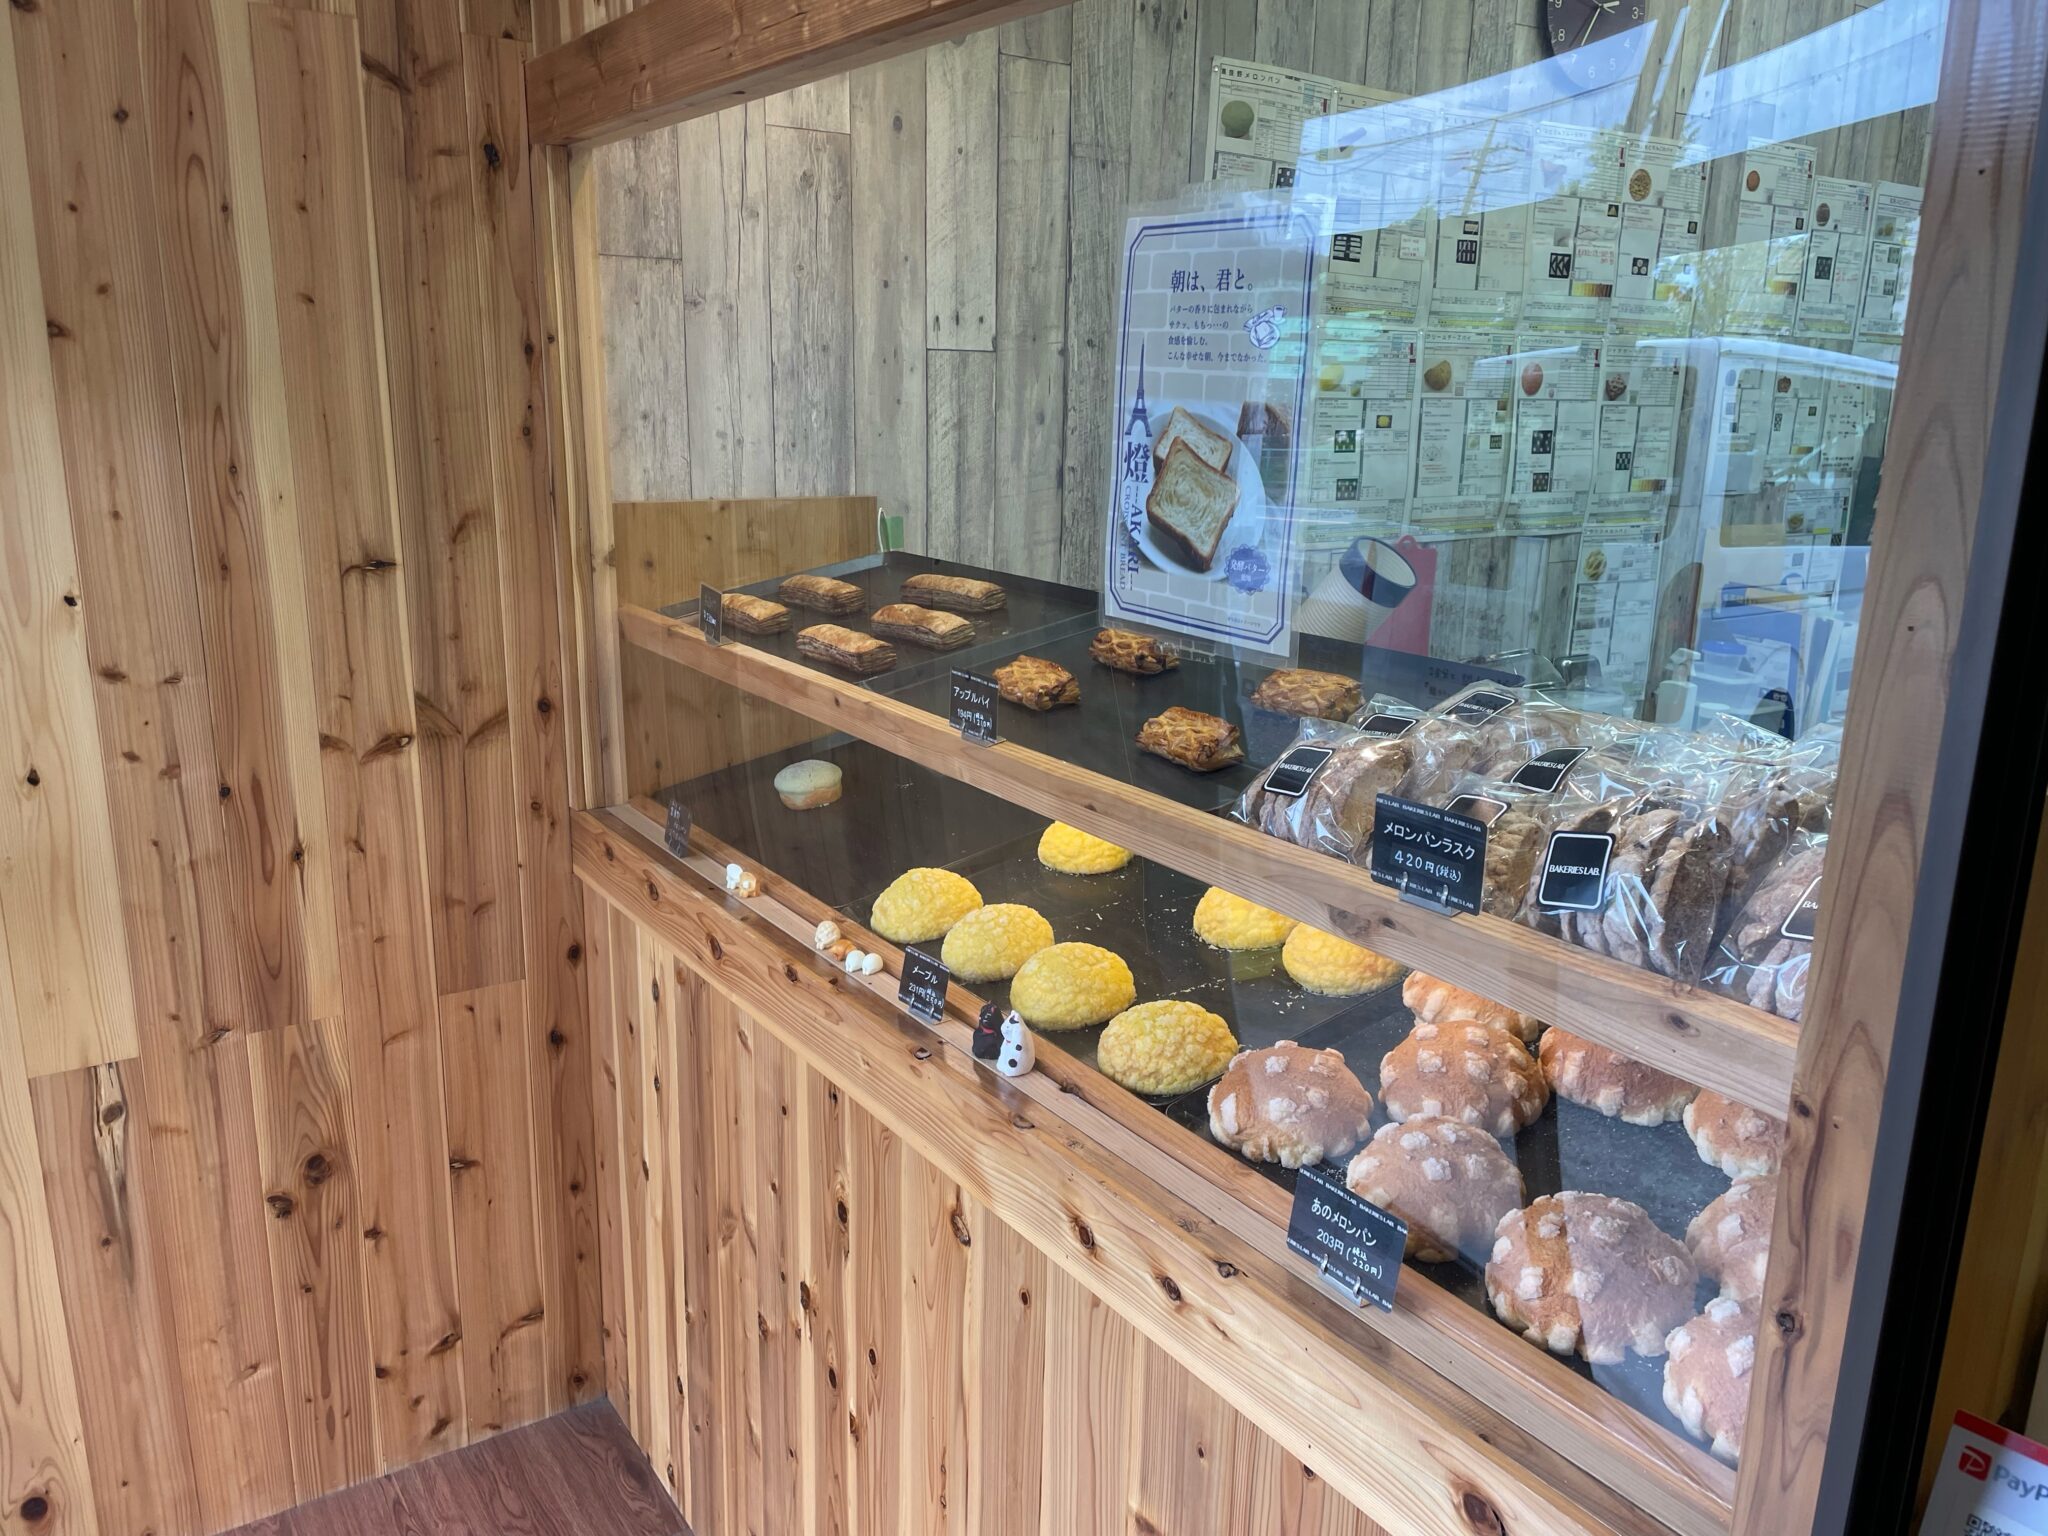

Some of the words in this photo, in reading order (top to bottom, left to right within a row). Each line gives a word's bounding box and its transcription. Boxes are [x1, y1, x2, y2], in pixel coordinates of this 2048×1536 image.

[1632, 7, 1639, 19] 3
[1558, 29, 1566, 41] 8
[1588, 66, 1595, 78] 6
[1171, 268, 1253, 293] 朝は、君と。
[1169, 303, 1253, 315] バターの香りに包まれながら
[1123, 441, 1151, 484] 燈
[1127, 503, 1143, 575] AKARI
[1384, 822, 1476, 860] メロンパンラスク
[1394, 850, 1462, 883] 420円(税込)
[1549, 864, 1584, 875] BAKERIES
[912, 965, 939, 985] メープル
[1311, 1197, 1377, 1247] あのメロンパン
[1993, 1464, 2048, 1501] PayP
